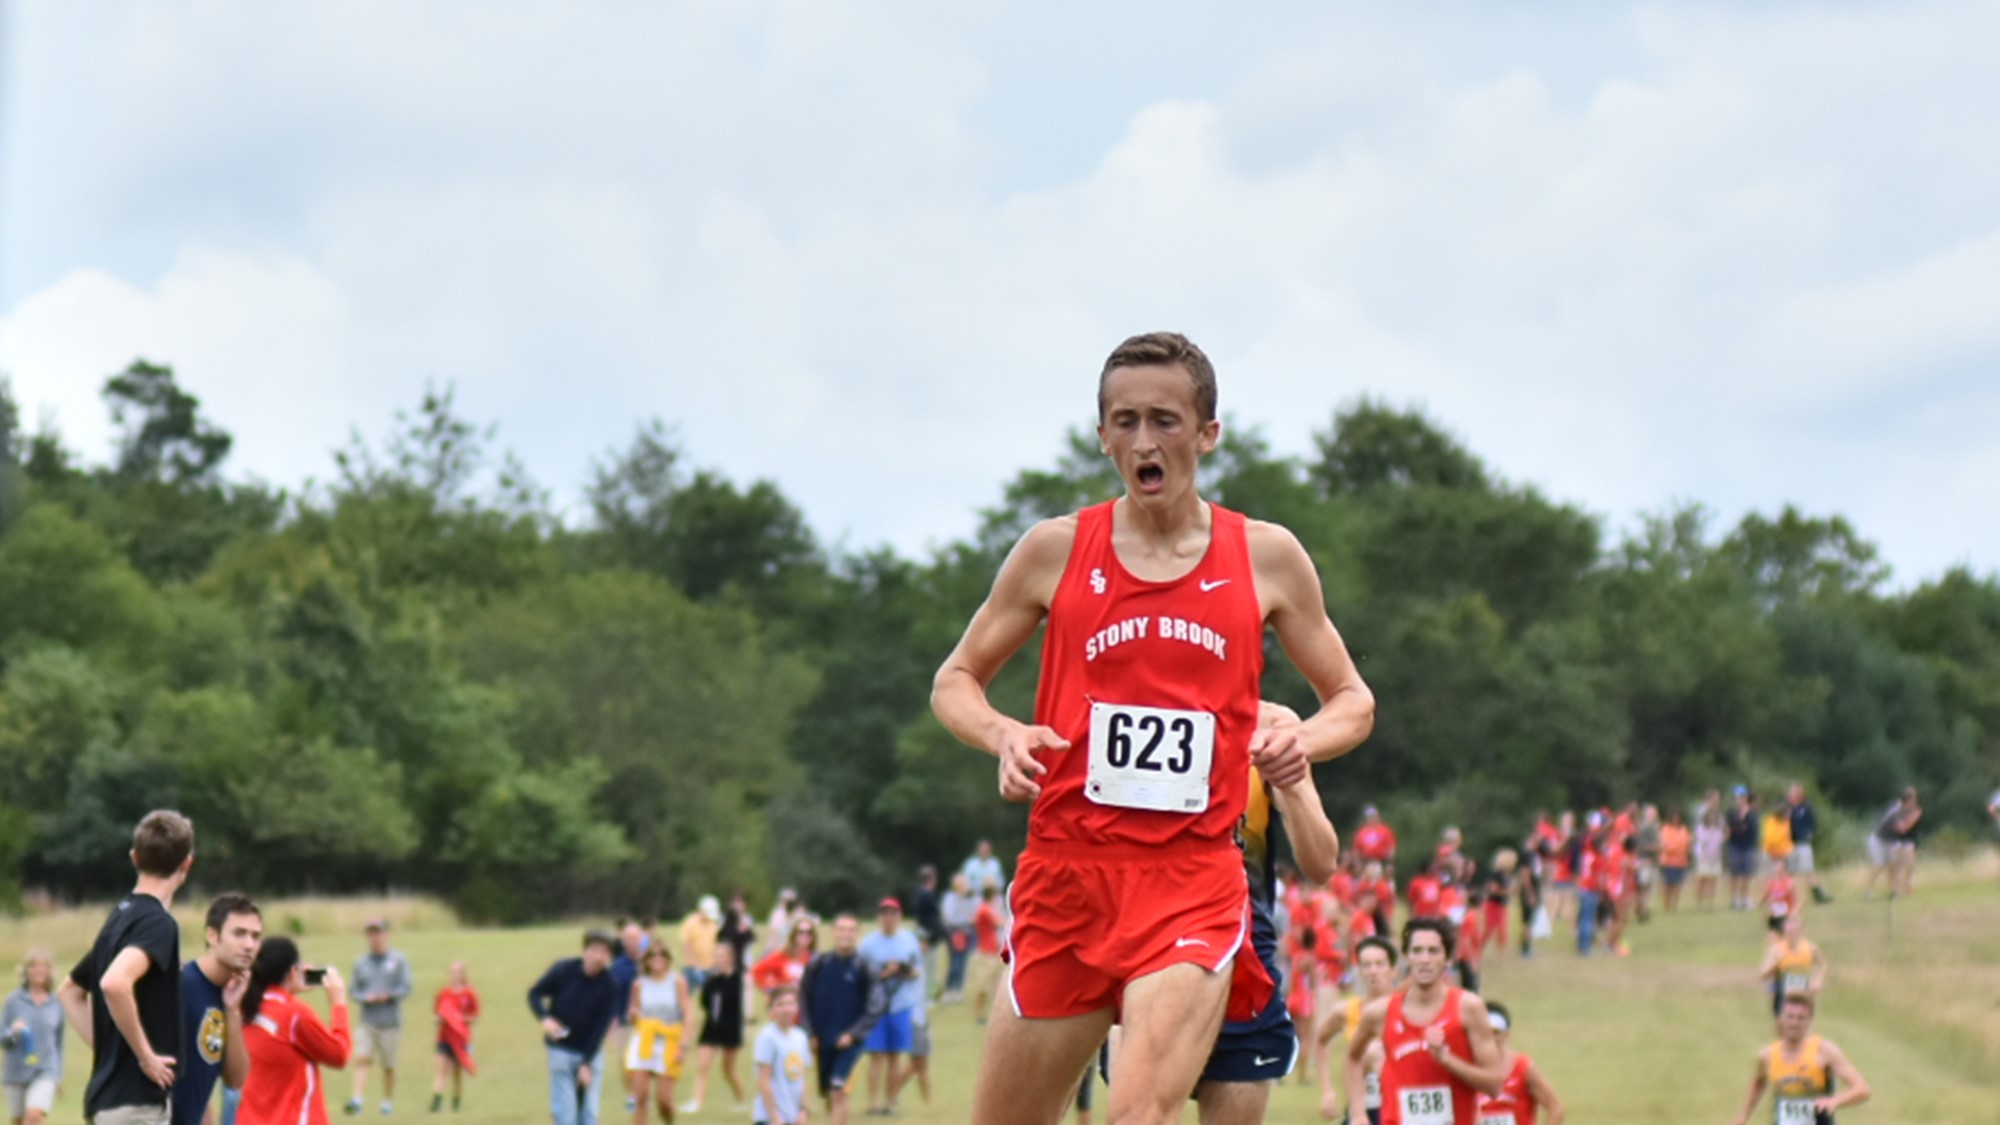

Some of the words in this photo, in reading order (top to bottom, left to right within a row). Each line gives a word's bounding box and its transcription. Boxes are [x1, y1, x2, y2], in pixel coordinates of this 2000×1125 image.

[1085, 616, 1150, 662] STONY
[1158, 616, 1227, 661] BROOK
[1106, 712, 1195, 775] 623
[1407, 1090, 1445, 1115] 638
